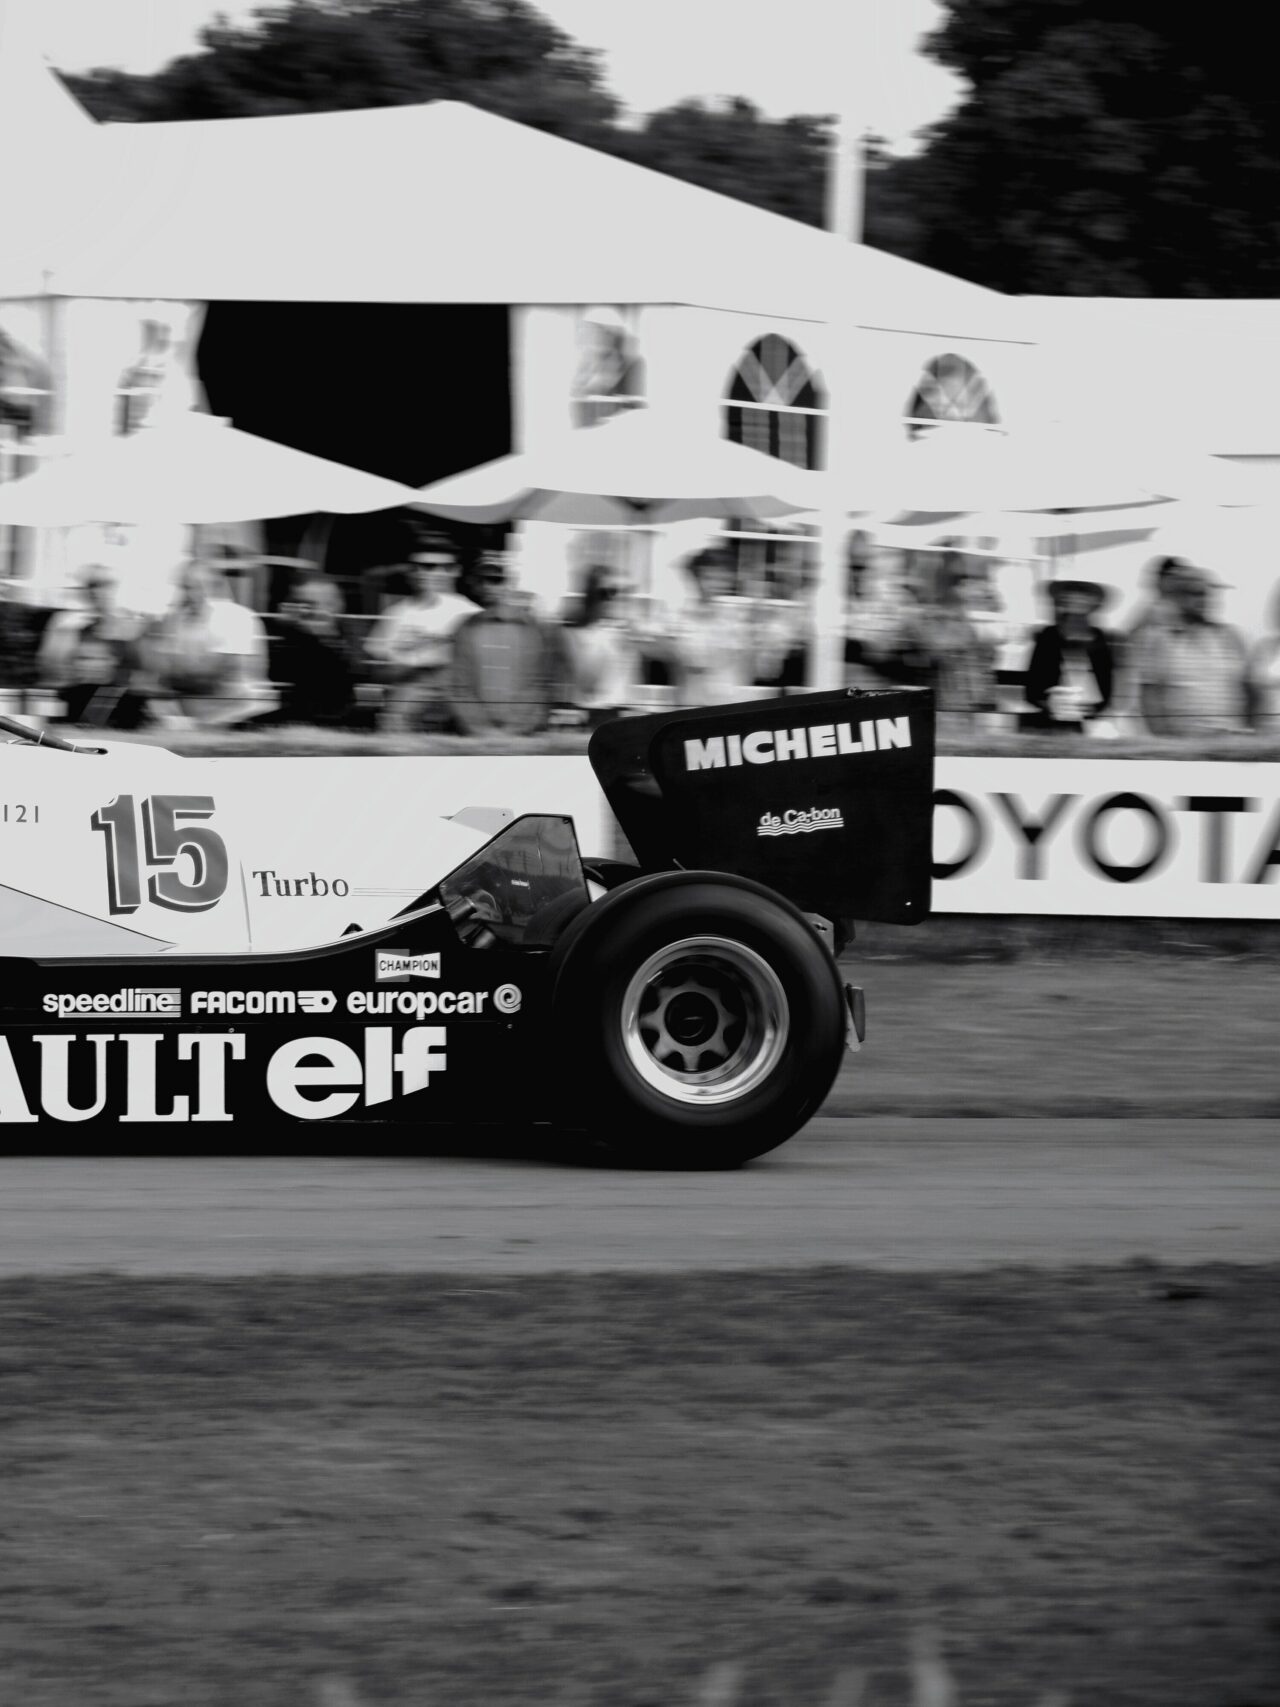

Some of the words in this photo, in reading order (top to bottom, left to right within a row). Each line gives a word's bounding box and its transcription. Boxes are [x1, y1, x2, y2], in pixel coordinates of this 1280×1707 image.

[685, 716, 912, 771] MICHELIN
[3, 804, 39, 824] 121
[760, 811, 782, 827] de
[931, 788, 1280, 885] OYOT
[91, 794, 229, 915] 15
[252, 870, 350, 898] Turbo
[380, 959, 439, 972] CHAMPION
[42, 988, 181, 1018] speedline
[190, 990, 296, 1014] FACOM
[346, 990, 489, 1020] europcar
[266, 1026, 447, 1120] elf
